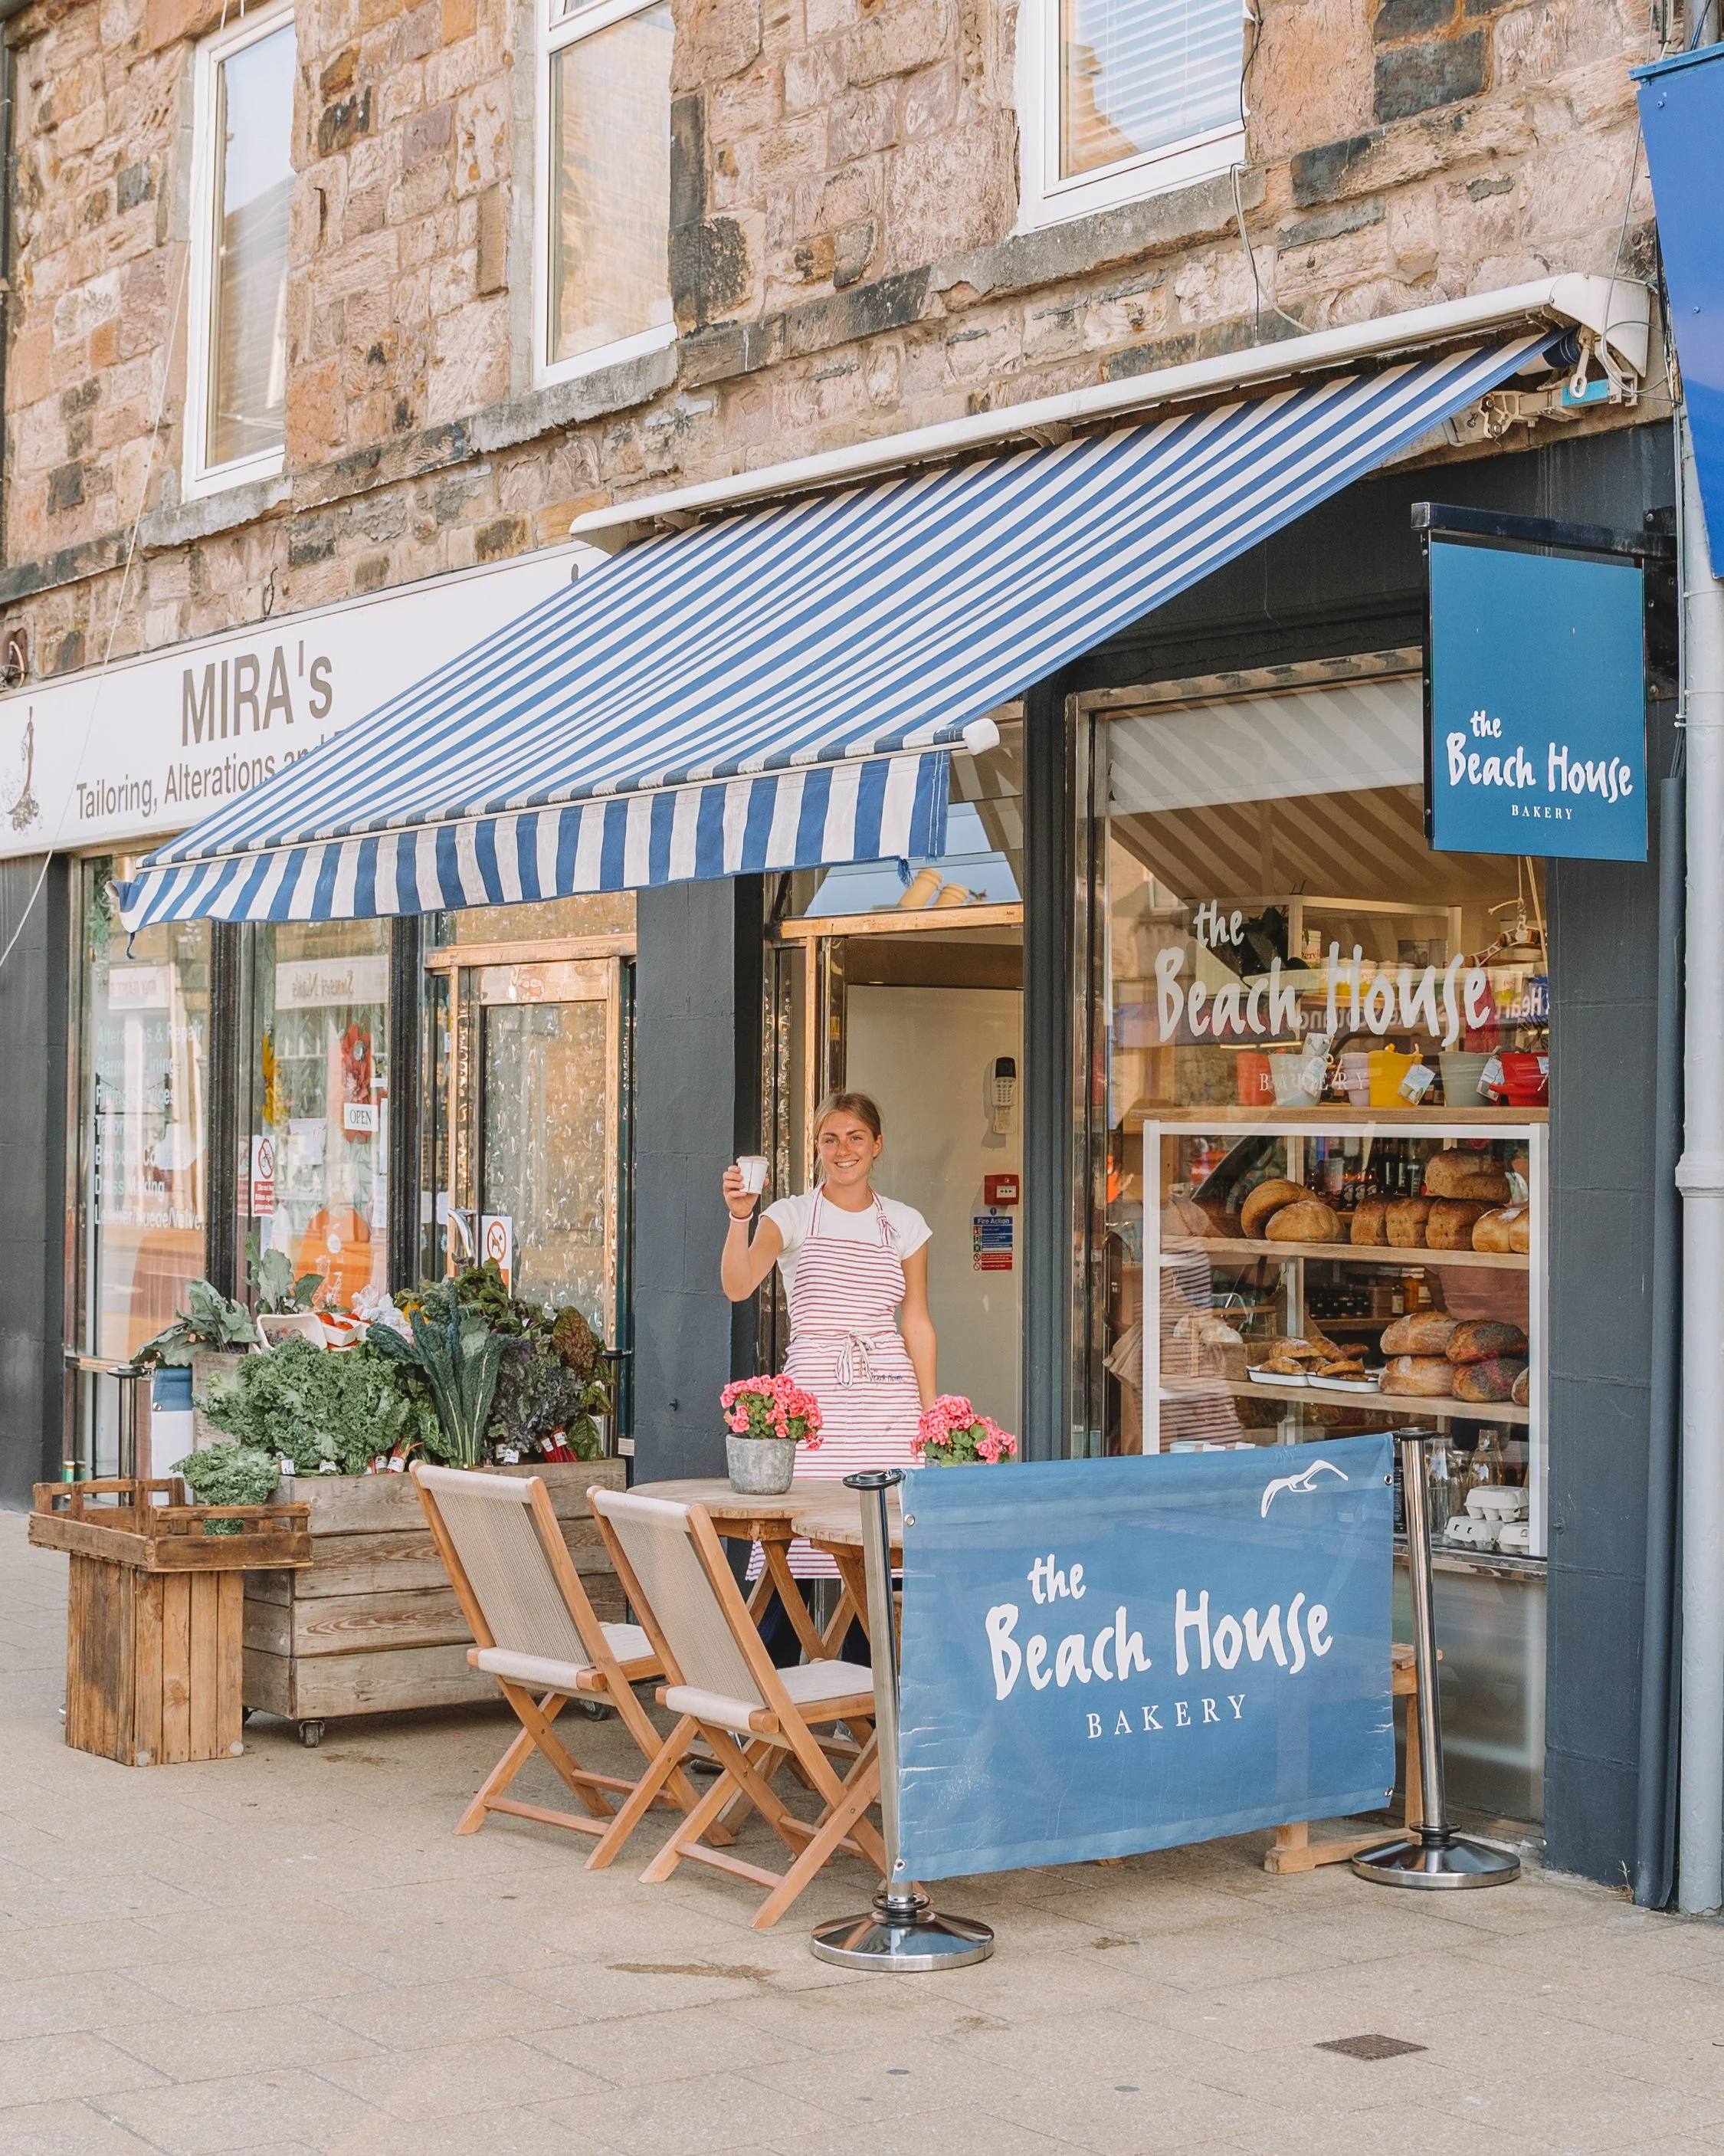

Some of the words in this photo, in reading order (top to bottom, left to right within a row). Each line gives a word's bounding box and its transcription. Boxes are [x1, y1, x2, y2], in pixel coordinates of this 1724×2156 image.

[182, 640, 333, 747] MIRA's
[1470, 710, 1503, 738] the
[77, 773, 158, 820] Tailoring,
[164, 753, 276, 805] Alterations
[1446, 732, 1536, 789] Beach
[1548, 742, 1634, 803] House
[1511, 804, 1573, 820] BAKERY
[1192, 899, 1245, 949] the
[1154, 946, 1303, 1043] Beach
[1326, 941, 1492, 1048] House
[156, 1021, 164, 1043] &
[349, 1109, 372, 1125] OPEN
[1027, 1553, 1087, 1604] the
[985, 1603, 1152, 1701] Beach
[1175, 1588, 1334, 1675] House
[1087, 1693, 1247, 1740] BAKERY
